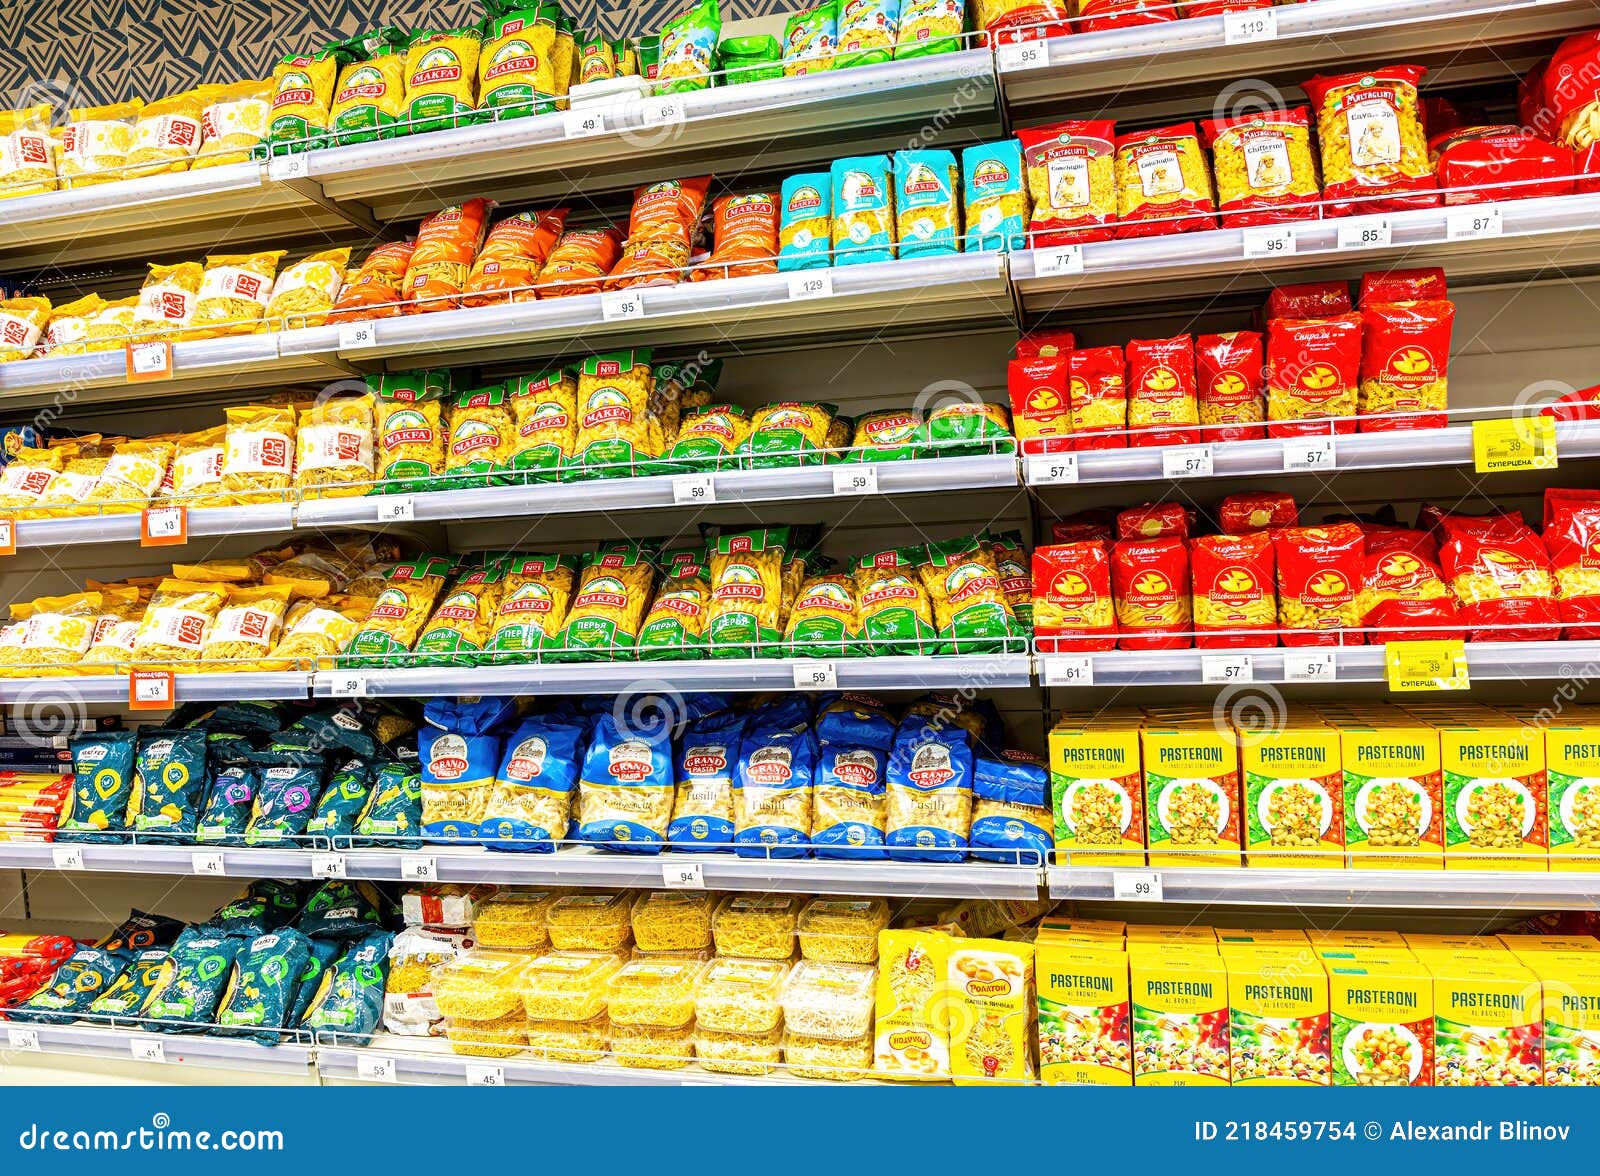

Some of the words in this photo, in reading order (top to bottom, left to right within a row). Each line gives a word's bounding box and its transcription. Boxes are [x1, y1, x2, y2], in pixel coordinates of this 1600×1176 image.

[1241, 21, 1264, 34] 119
[1021, 50, 1036, 61] 95
[489, 59, 535, 77] MAKFA
[414, 68, 456, 84] MAKFA
[661, 105, 674, 117] 65
[582, 120, 595, 130] 49
[975, 172, 1008, 186] MAKFA
[906, 181, 939, 194] MAKFA
[640, 188, 678, 206] MAKFA
[727, 202, 770, 217] MAKFA
[789, 198, 820, 212] MAKFA
[1473, 218, 1489, 230] 87
[1362, 230, 1378, 241] 85
[1267, 239, 1283, 250] 95
[1056, 255, 1070, 265] 77
[804, 279, 823, 291] 129
[621, 302, 634, 313] 95
[1294, 331, 1330, 343] Спирали
[151, 355, 161, 365] 13
[586, 409, 627, 425] MAKFA
[522, 417, 563, 434] MAKFA
[386, 430, 427, 445] MAKFA
[455, 437, 496, 453] MAKFA
[1509, 441, 1521, 452] 39
[1307, 451, 1322, 463] 57
[1186, 459, 1200, 470] 57
[1487, 459, 1532, 468] СУПЕРЦЕНА
[1051, 466, 1065, 477] 57
[853, 477, 866, 487] 59
[691, 487, 704, 497] 59
[394, 506, 405, 515] 61
[165, 520, 175, 531] 13
[716, 584, 763, 599] MAKFA
[864, 588, 914, 601] MAKFA
[577, 594, 624, 606] MAKFA
[799, 598, 850, 610] MAKFA
[504, 601, 549, 613] MAKFA
[654, 599, 698, 614] MAKFA
[577, 621, 607, 630] ПЕРЬЯ
[650, 621, 677, 632] ПЕРЬЯ
[1225, 667, 1240, 677] 57
[1308, 664, 1323, 675] 57
[1429, 662, 1441, 672] 39
[812, 672, 825, 682] 59
[1066, 668, 1080, 679] 61
[346, 681, 357, 690] 59
[1401, 680, 1437, 688] СУПЕРЦЕ
[150, 687, 160, 696] 13
[1063, 748, 1125, 763] PASTERONI
[1160, 747, 1223, 763] PASTERONI
[1260, 747, 1326, 763] PASTERONI
[1358, 745, 1425, 761] PASTERONI
[1459, 745, 1529, 761] PASTERONI
[432, 760, 466, 771] GRAND
[509, 759, 541, 773] GRAND
[611, 761, 653, 773] GRAND
[685, 755, 725, 768] GRAND
[438, 770, 459, 779] PASTA
[510, 769, 532, 779] PASTA
[692, 766, 716, 775] PASTA
[748, 764, 791, 777] GRAND
[835, 764, 876, 779] GRAND
[911, 769, 953, 781] GRAND
[619, 772, 644, 781] PASTA
[757, 775, 781, 784] PASTA
[844, 775, 868, 785] PASTA
[919, 778, 942, 786] PASTA
[686, 790, 717, 802] Fusilli
[752, 800, 786, 811] Fusilli
[838, 797, 873, 810] Fusilli
[911, 800, 945, 811] Fusilli
[67, 857, 76, 865] 41
[207, 862, 216, 871] 41
[327, 864, 337, 873] 41
[416, 866, 428, 875] 83
[681, 872, 693, 882] 94
[1135, 883, 1150, 894] 99
[1050, 973, 1114, 992] PASTERONI
[1147, 980, 1213, 998] PASTERONI
[1245, 985, 1313, 1003] PASTERONI
[1347, 989, 1417, 1008] PASTERONI
[1451, 991, 1525, 1011] PASTERONI
[373, 1065, 385, 1076] 53
[483, 1074, 496, 1085] 45
